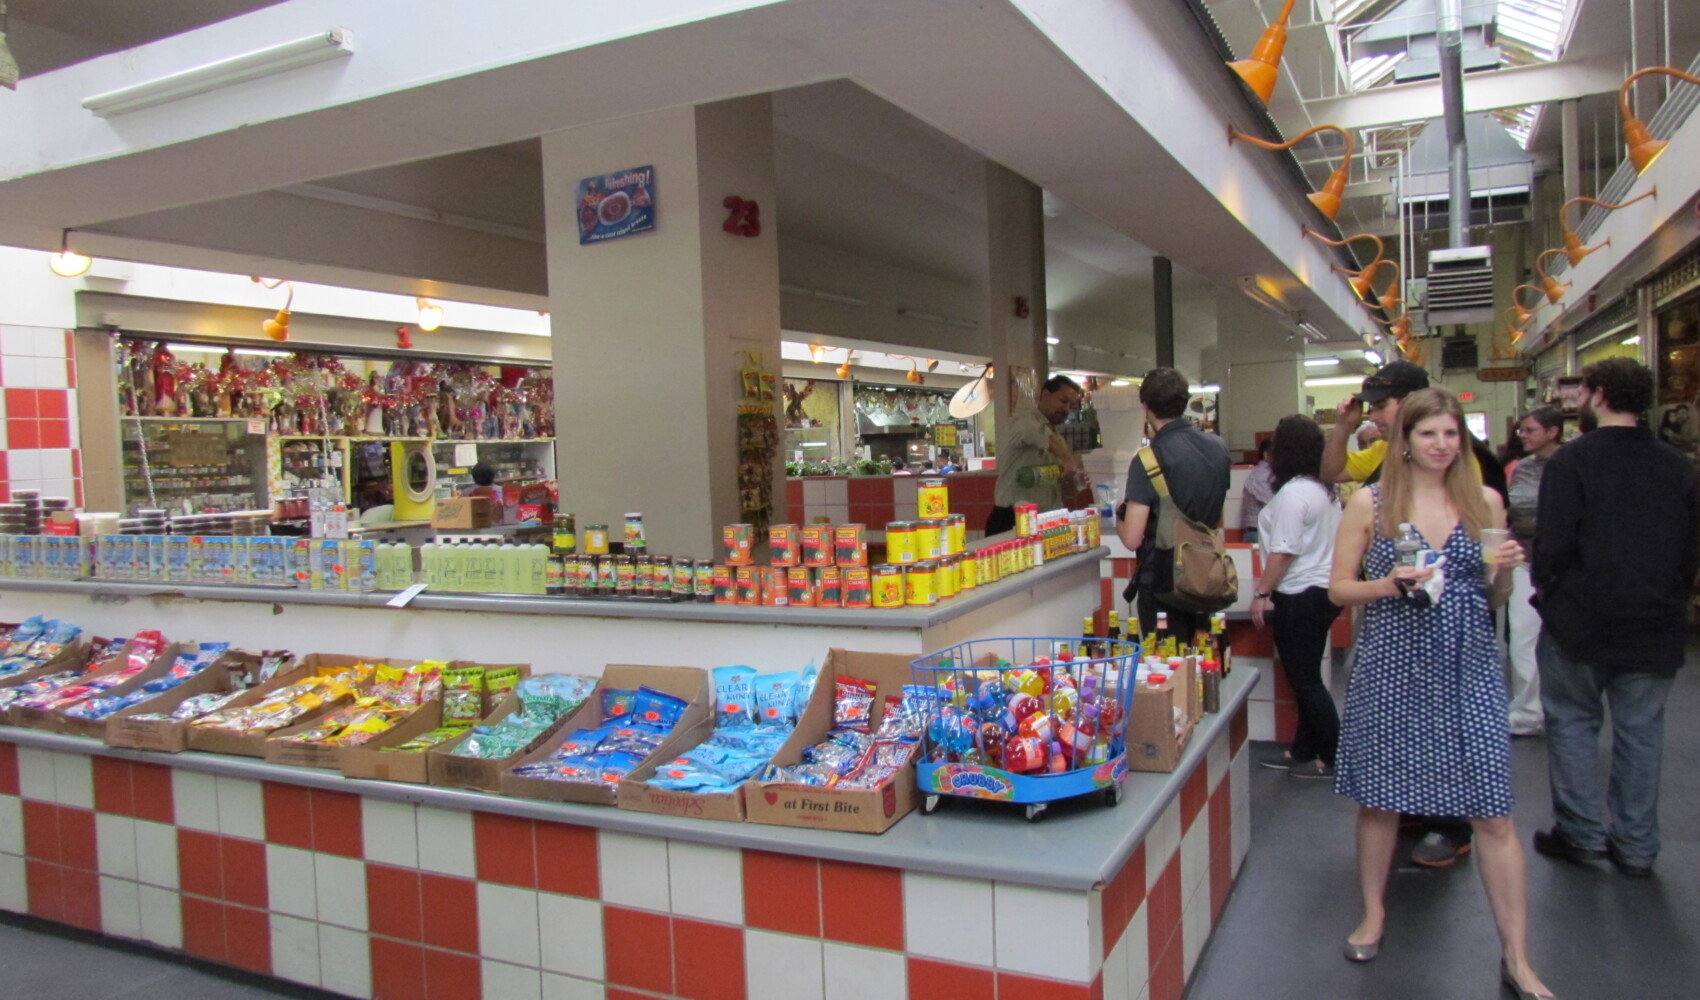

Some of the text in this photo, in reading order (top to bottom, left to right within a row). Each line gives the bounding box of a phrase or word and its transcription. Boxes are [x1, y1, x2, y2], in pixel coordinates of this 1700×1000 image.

[722, 195, 761, 238] 23
[395, 326, 413, 348] 1
[951, 772, 1005, 794] CHUBBY
[784, 798, 860, 814] at First Bite
